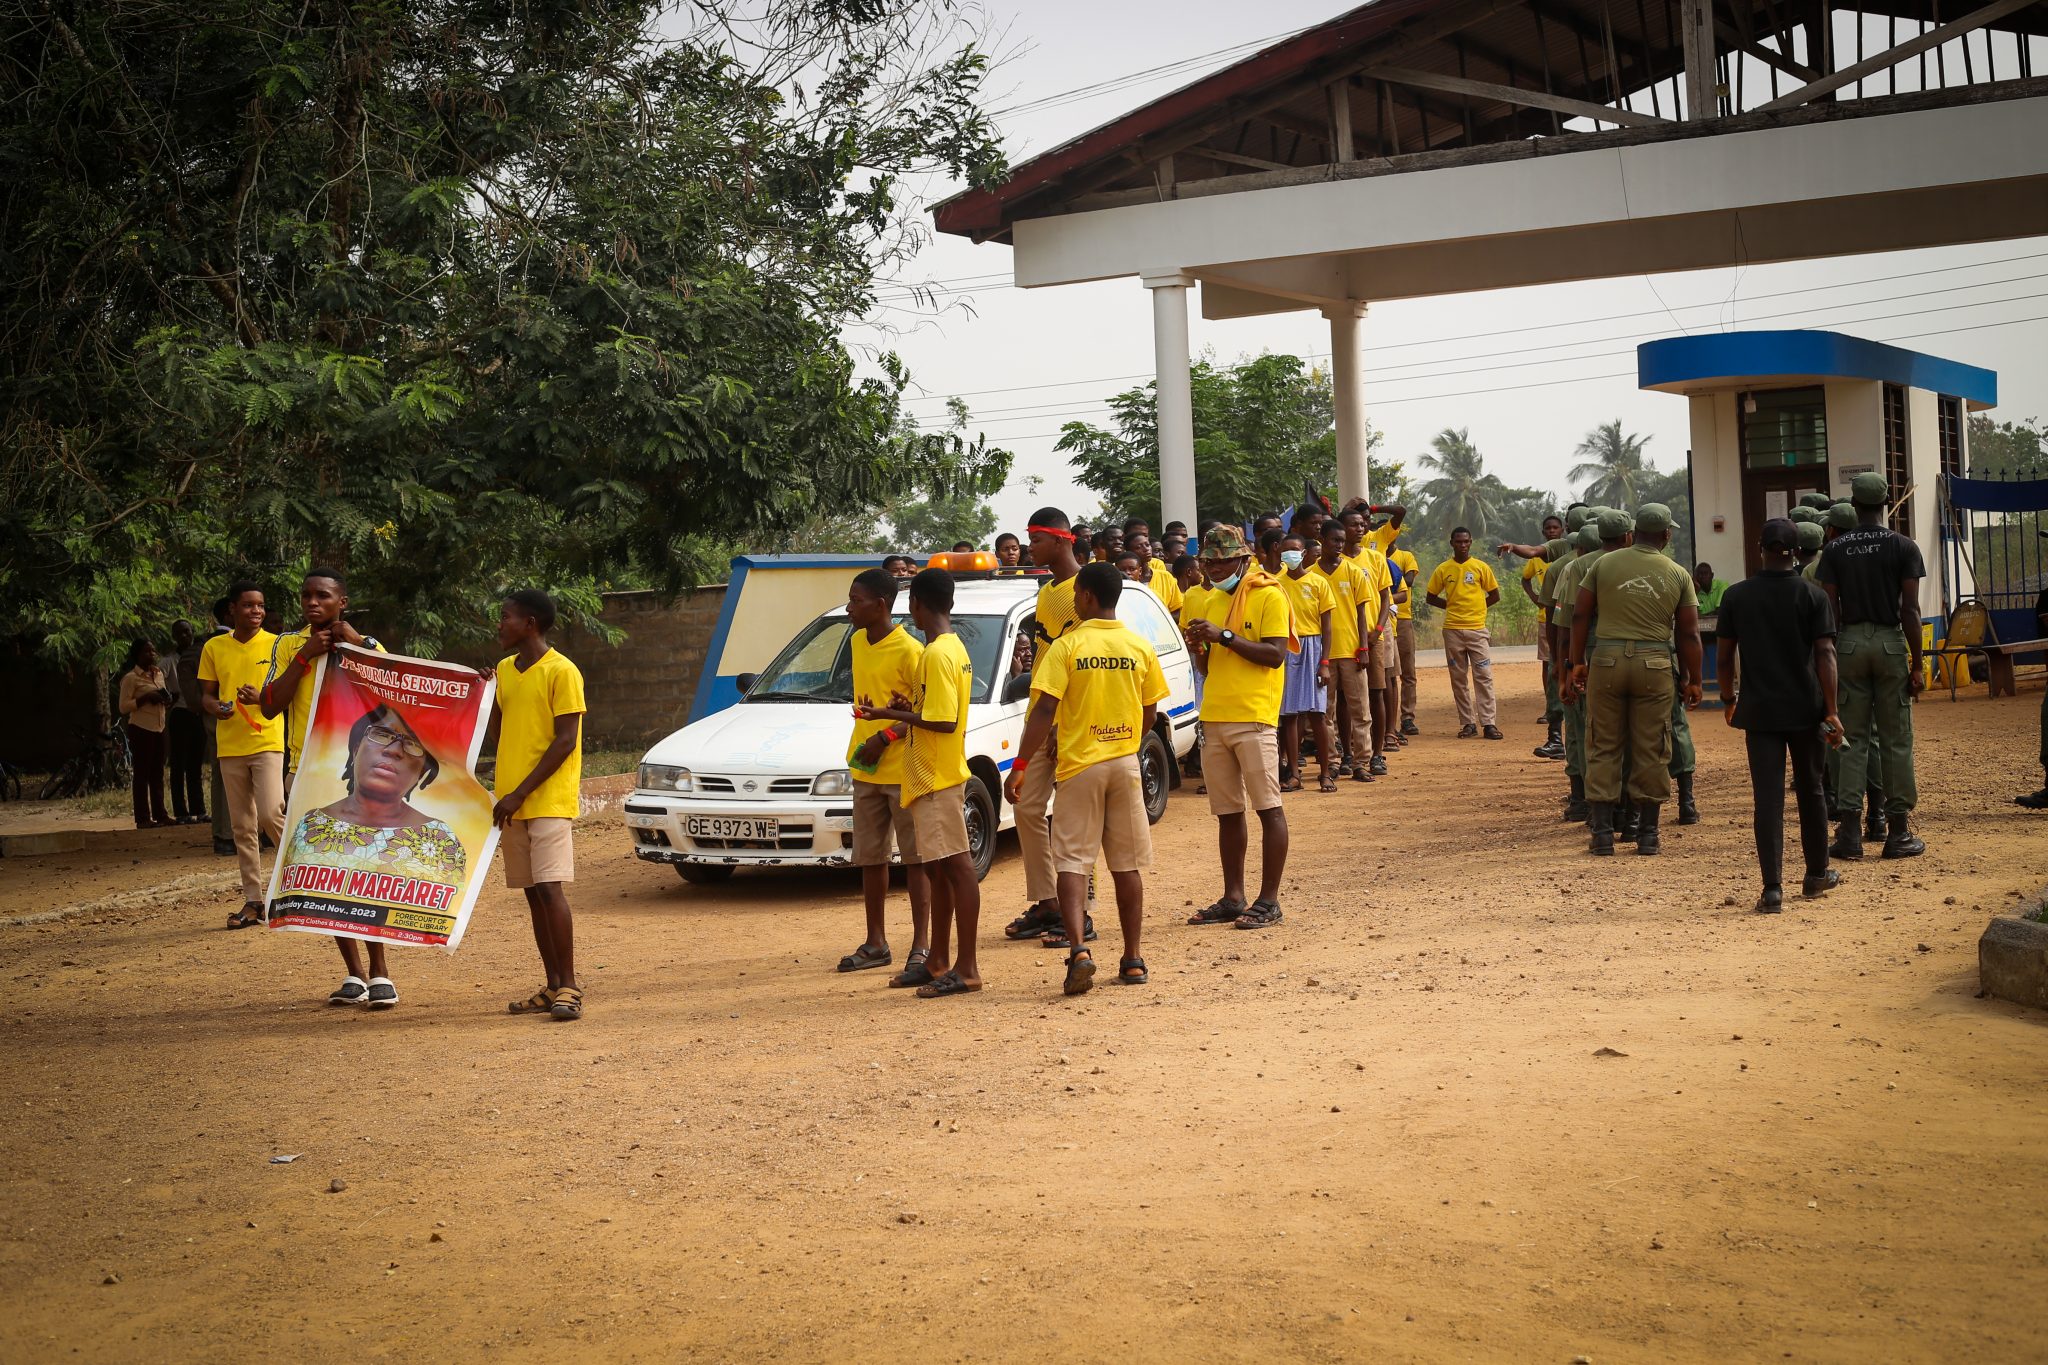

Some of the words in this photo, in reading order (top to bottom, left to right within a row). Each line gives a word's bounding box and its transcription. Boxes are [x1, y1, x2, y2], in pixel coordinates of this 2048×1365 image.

[1076, 657, 1137, 671] MORDEY
[366, 683, 381, 696] OR
[380, 689, 395, 700] THE
[396, 691, 418, 706] LATE
[401, 673, 469, 698] SERVICE
[293, 863, 348, 895] DORM
[346, 870, 457, 910] MARGARET
[303, 901, 326, 911] 22nd
[350, 907, 376, 917] 2023
[395, 912, 436, 923] FORECOURT
[306, 918, 327, 926] Clothes
[335, 921, 347, 929] Red
[397, 932, 424, 942] 2:30pm
[393, 919, 419, 928] ADISEC
[420, 922, 449, 931] LIBRARY
